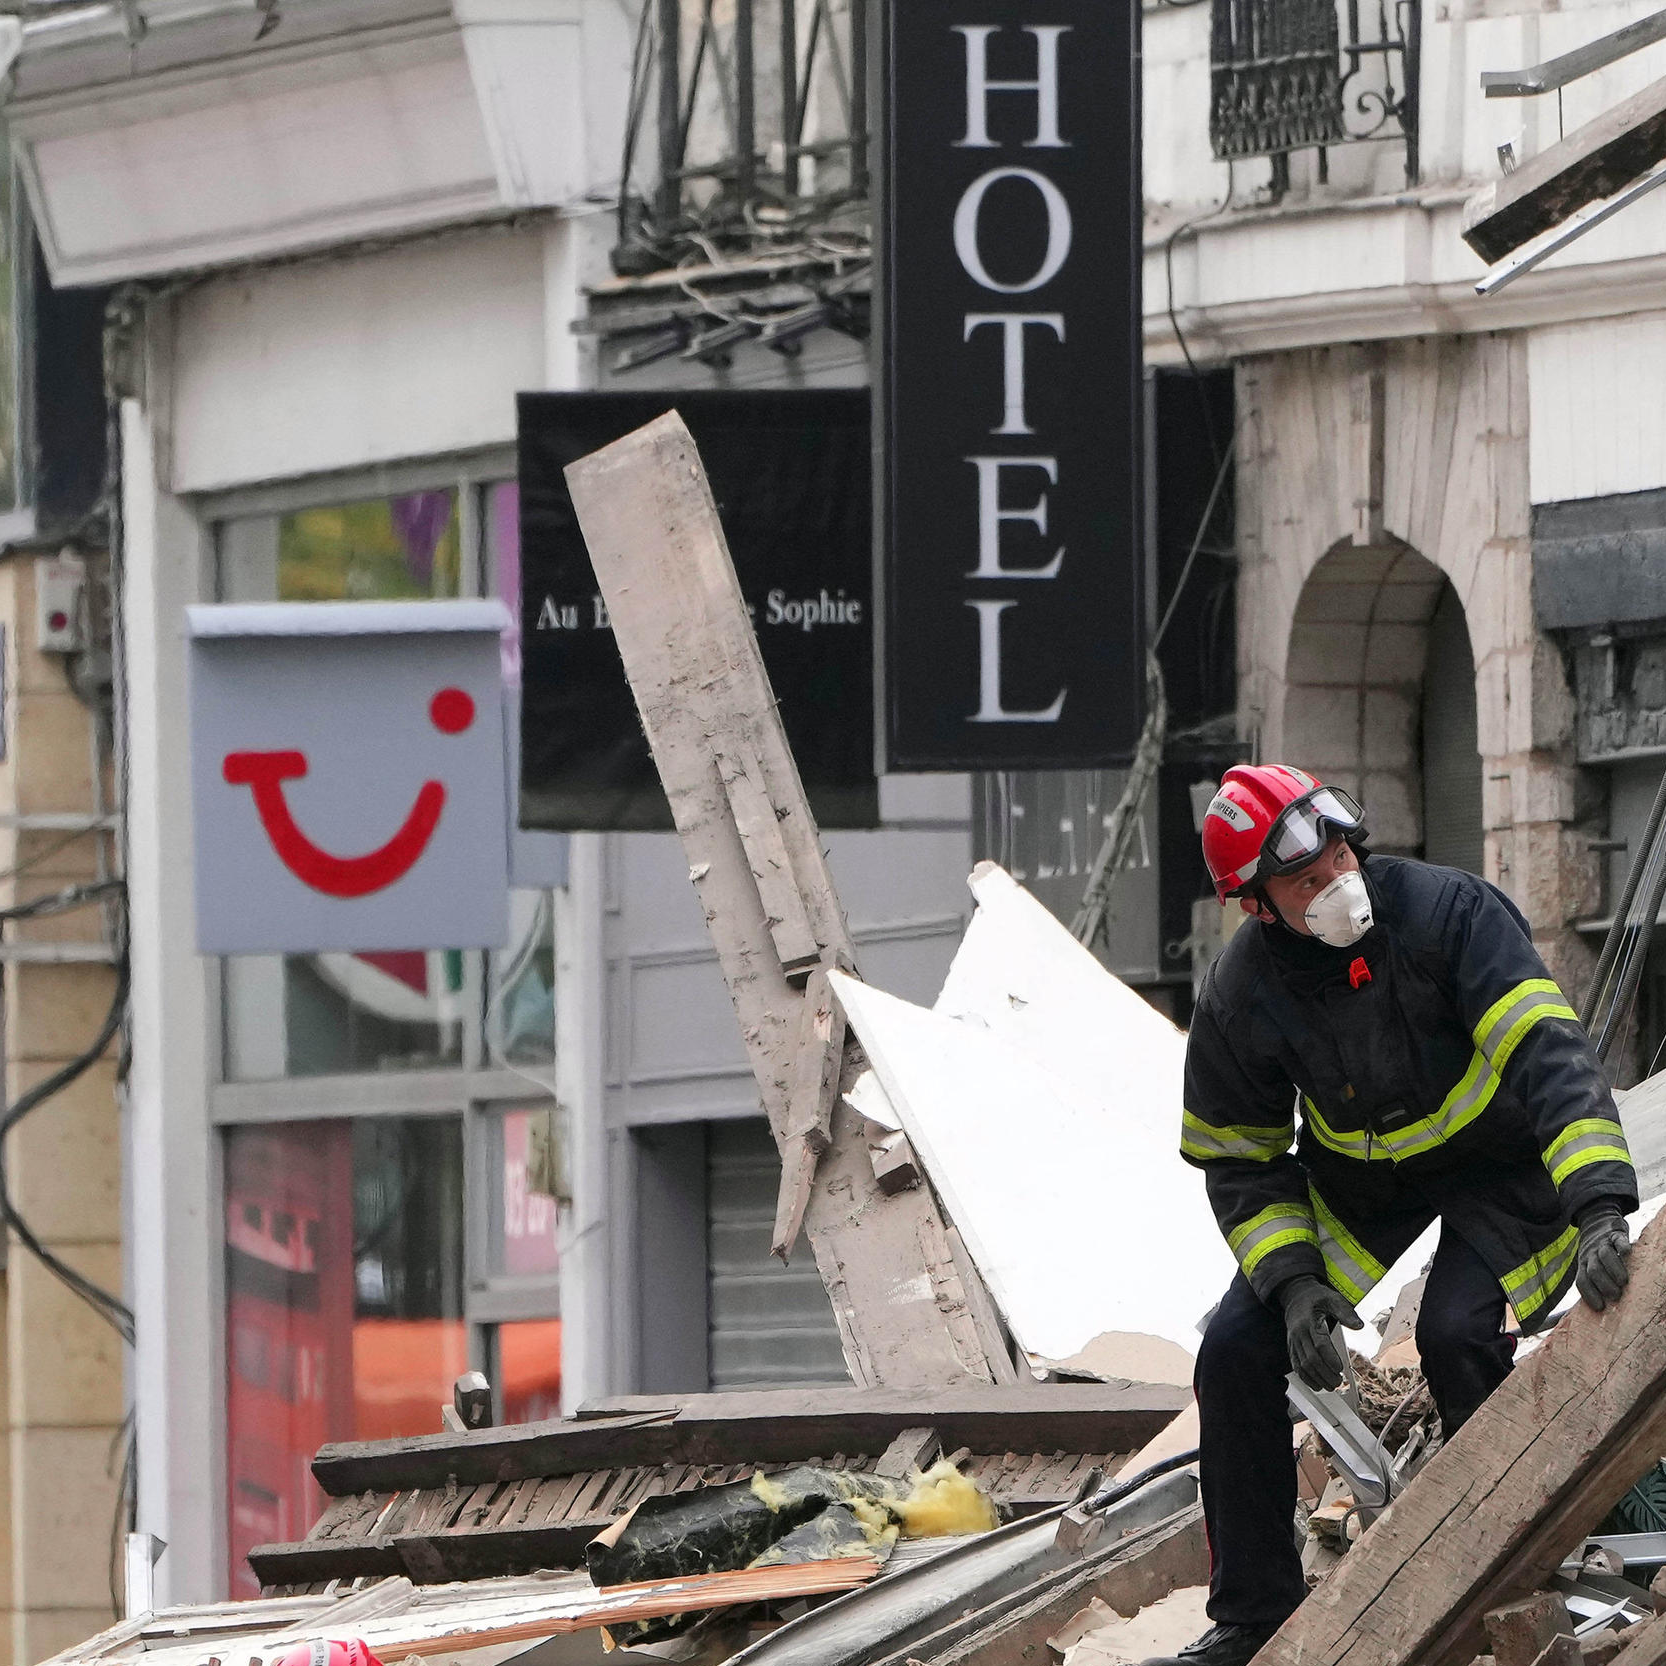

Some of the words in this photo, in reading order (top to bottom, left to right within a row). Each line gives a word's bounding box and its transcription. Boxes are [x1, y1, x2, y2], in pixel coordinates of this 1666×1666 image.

[949, 24, 1075, 724] HOTEL
[536, 594, 579, 631] Au
[765, 588, 862, 632] Sophie
